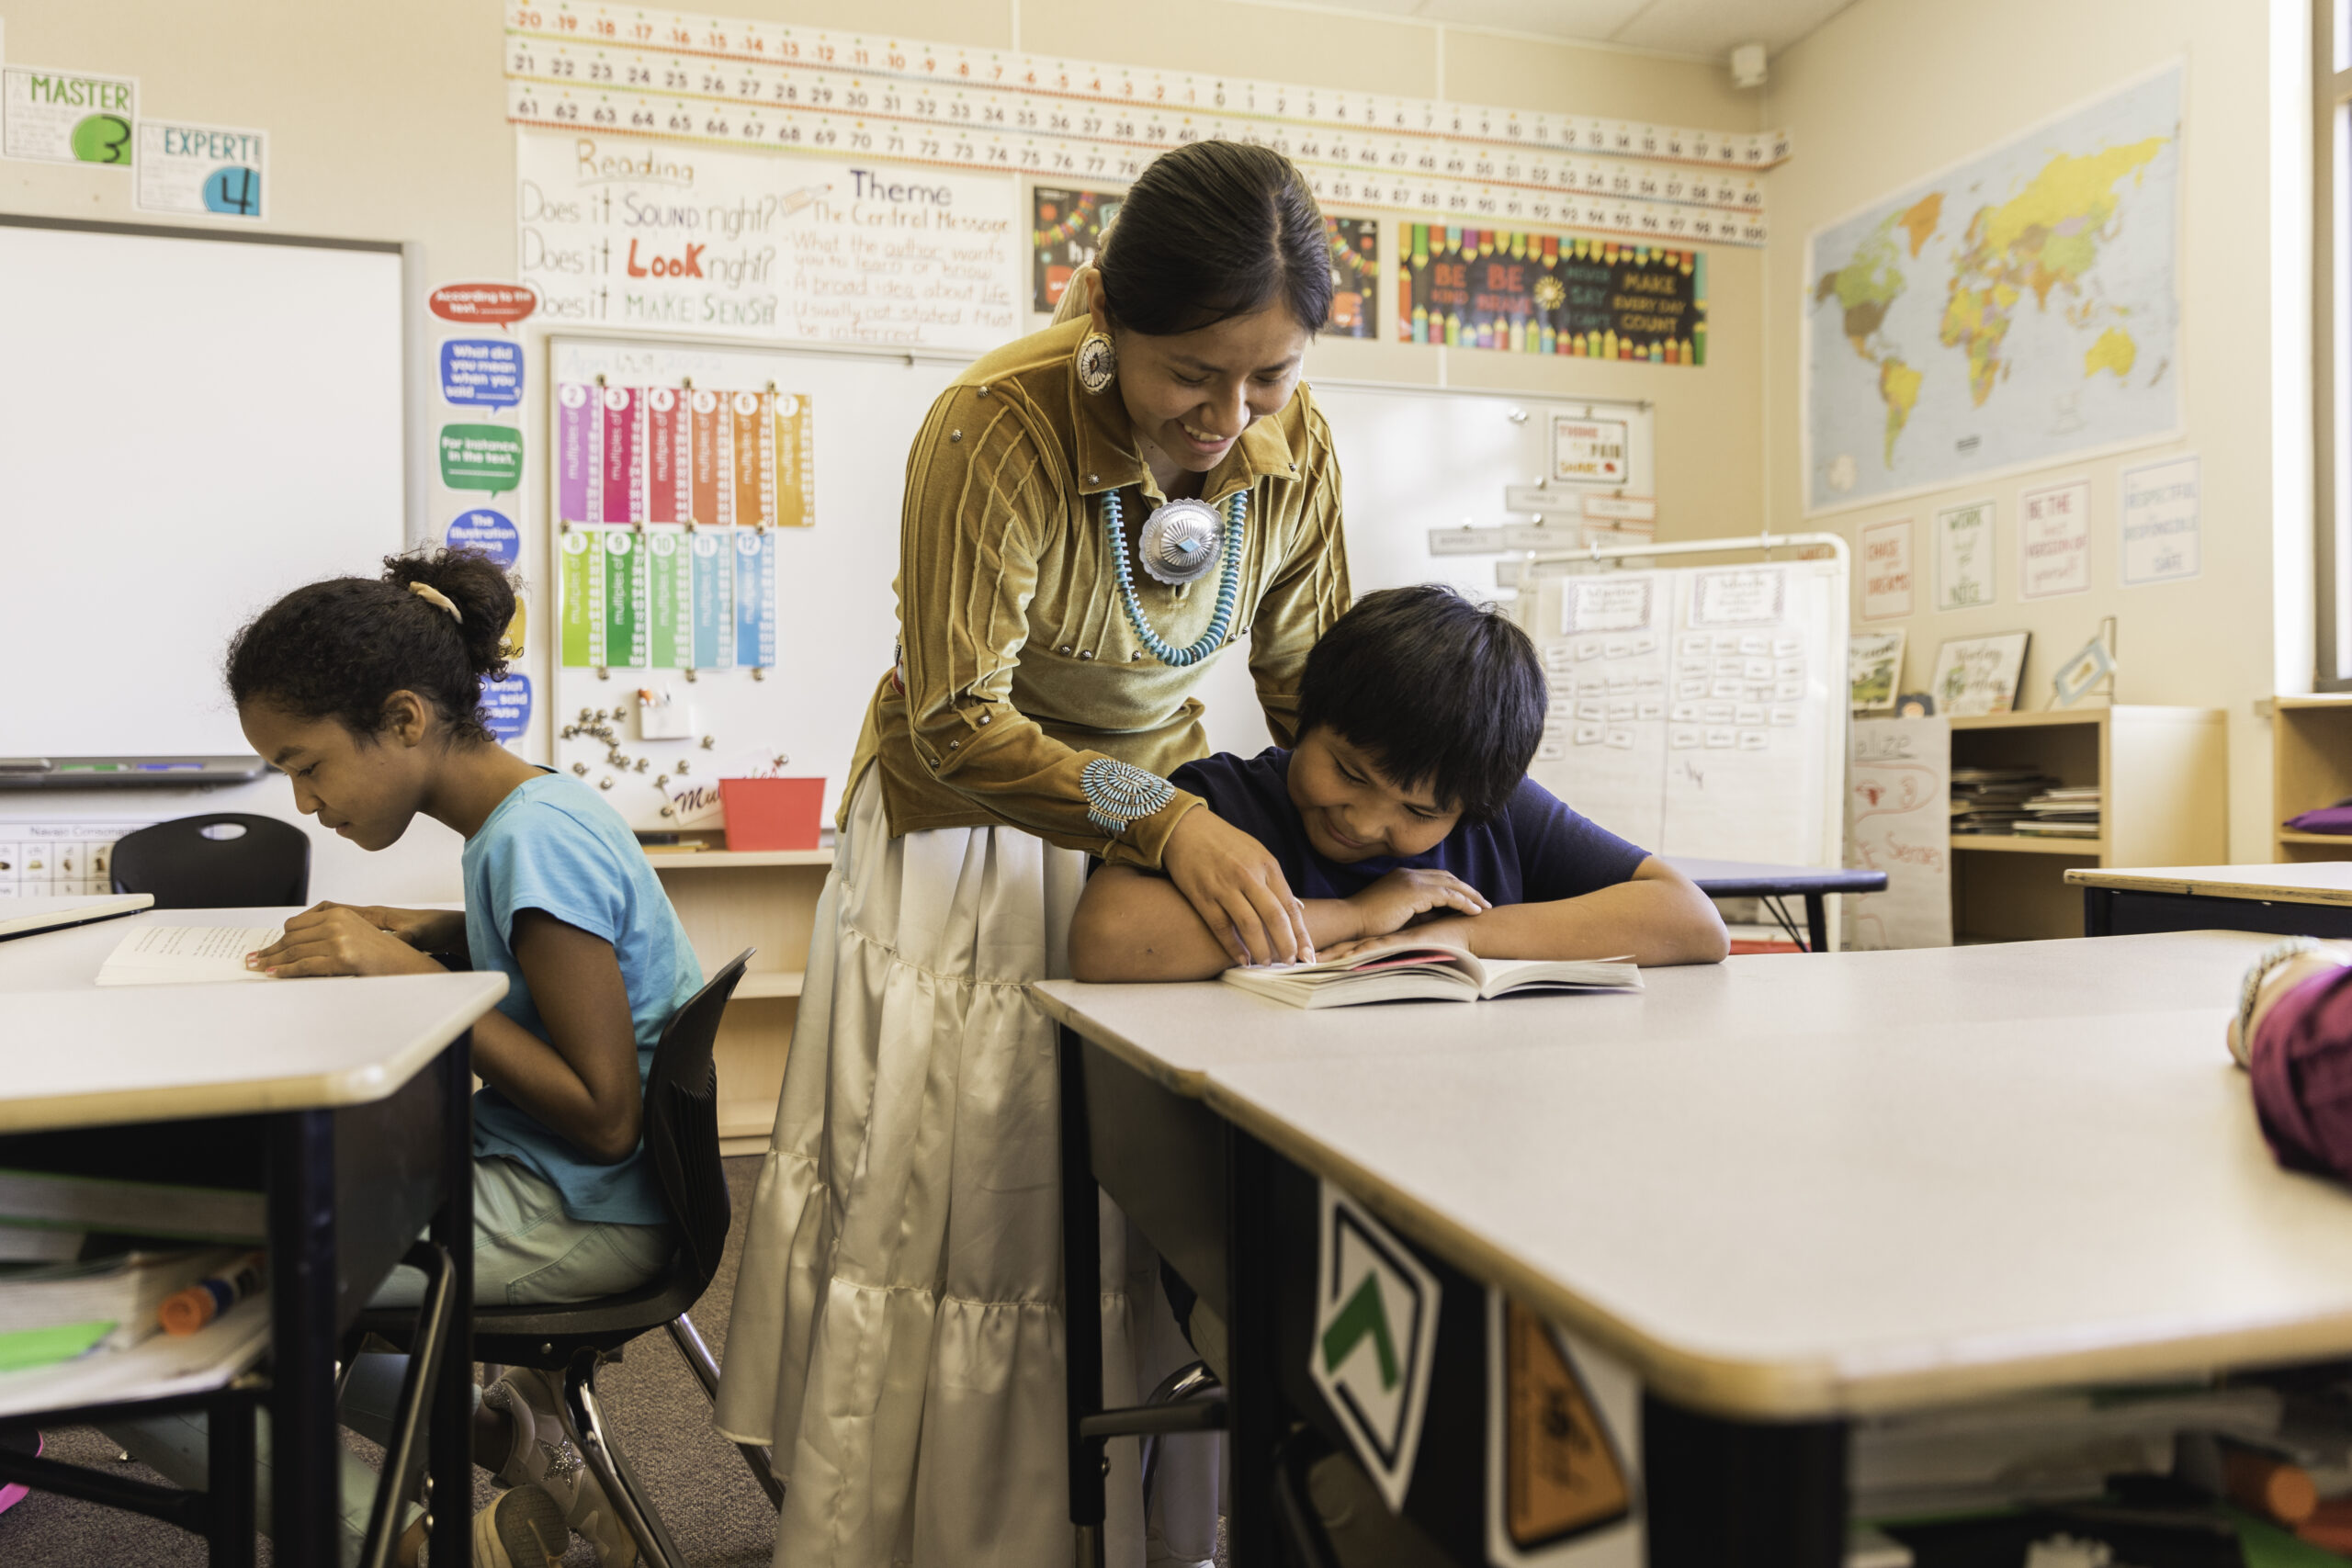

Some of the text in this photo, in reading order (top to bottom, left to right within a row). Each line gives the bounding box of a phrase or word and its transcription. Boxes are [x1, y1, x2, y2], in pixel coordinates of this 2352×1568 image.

[31, 74, 130, 110] MASTER
[514, 53, 936, 116] 21 22 23 24 25 26 27 28 29 30 31 32
[101, 114, 130, 164] 3
[517, 99, 941, 156] 61 62 63 64 65 66 67 68 69 70 71 72
[164, 128, 260, 163] EXPERT!
[575, 138, 695, 183] Reading
[221, 167, 254, 215] 4
[849, 168, 953, 207] Theme
[521, 180, 582, 223] Does
[592, 186, 611, 224] it
[707, 194, 778, 242] right?
[814, 199, 842, 222] The
[851, 231, 877, 254] the
[522, 227, 584, 271] Does
[590, 237, 609, 275] it
[709, 246, 777, 291] right?
[1433, 263, 1467, 288] BE
[1486, 263, 1524, 292] BE
[1623, 271, 1678, 296] MAKE
[435, 289, 532, 304] According to the
[589, 285, 607, 320] it
[626, 294, 692, 322] MAKE
[1430, 288, 1469, 305] KIND
[1612, 293, 1688, 316] EVERY DAY
[1621, 313, 1679, 333] COUNT
[452, 344, 514, 360] What did
[450, 359, 516, 373] you mean
[446, 385, 475, 399] said
[450, 372, 516, 388] when you
[568, 388, 579, 405] 2
[612, 390, 622, 406] 3
[656, 391, 665, 407] 4
[700, 393, 709, 408] 5
[741, 395, 752, 410] 6
[442, 435, 463, 450] For
[566, 422, 580, 479] multiples
[611, 425, 622, 480] multiples
[656, 426, 668, 481] multiples
[462, 450, 484, 463] the
[698, 428, 710, 483] multiples
[741, 429, 752, 484] multiples
[470, 513, 495, 527] The
[614, 535, 624, 551] 9
[741, 534, 755, 549] 12
[570, 569, 581, 625] multiples
[613, 570, 625, 625] multiples
[743, 570, 755, 625] multiples
